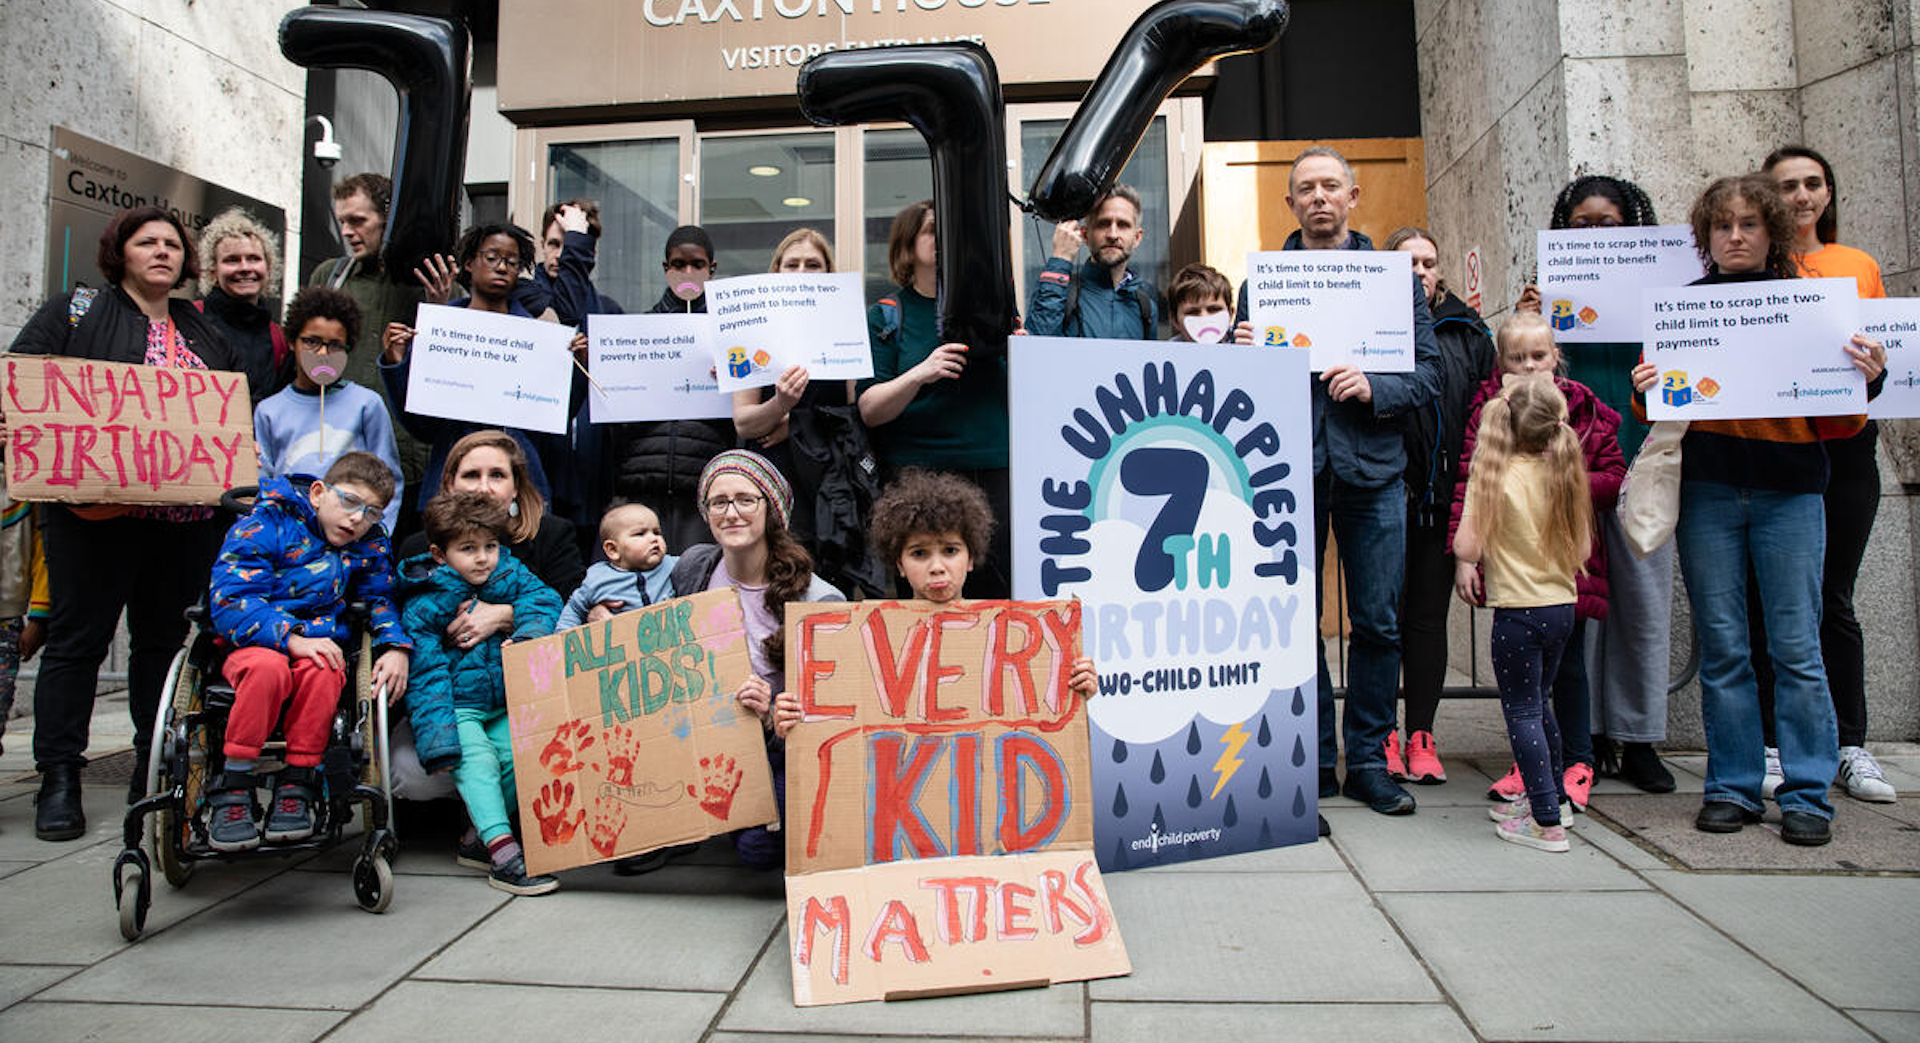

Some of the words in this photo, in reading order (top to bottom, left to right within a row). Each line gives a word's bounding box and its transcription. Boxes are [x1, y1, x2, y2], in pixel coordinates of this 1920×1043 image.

[70, 152, 115, 175] Welcome
[116, 169, 128, 181] to
[1549, 242, 1563, 251] It's
[1567, 241, 1591, 250] time
[1594, 241, 1605, 249] to
[1608, 240, 1636, 250] scrap
[1639, 238, 1658, 248] the
[1661, 239, 1688, 247] two-
[1548, 256, 1573, 266] child
[1576, 256, 1600, 265] limit
[1603, 256, 1615, 264] to
[1617, 254, 1657, 264] benefit
[1257, 264, 1273, 274] It's
[1276, 264, 1300, 273] time
[1303, 264, 1314, 273] to
[1317, 265, 1343, 275] scrap
[1346, 264, 1362, 273] the
[1364, 265, 1388, 273] two-
[1548, 273, 1600, 283] payments
[732, 287, 756, 298] time
[758, 285, 768, 294] to
[771, 284, 797, 294] scrap
[799, 283, 815, 293] the
[1258, 280, 1284, 290] child
[1286, 280, 1310, 289] limit
[1313, 281, 1324, 289] to
[1327, 279, 1362, 290] benefit
[718, 304, 741, 316] child
[743, 299, 766, 312] limit
[769, 299, 780, 308] to
[782, 298, 817, 308] benefit
[1259, 297, 1311, 307] payments
[1654, 301, 1673, 313] It's
[1677, 299, 1706, 312] time
[1710, 300, 1724, 309] to
[1727, 297, 1763, 310] scrap
[1766, 294, 1789, 306] the
[1793, 293, 1826, 304] two-
[719, 315, 768, 331] payments
[1655, 318, 1686, 331] child
[1689, 317, 1719, 329] limit
[1723, 317, 1736, 327] to
[1740, 313, 1790, 326] benefit
[1865, 323, 1887, 332] end
[1889, 322, 1917, 332] child
[431, 327, 447, 338] It's
[449, 329, 473, 342] time
[475, 334, 486, 344] to
[488, 337, 508, 347] end
[510, 337, 534, 351] child
[615, 337, 638, 346] time
[639, 338, 651, 346] to
[652, 336, 670, 345] end
[672, 335, 696, 344] child
[1656, 337, 1720, 351] payments
[1885, 339, 1903, 349] UK
[428, 343, 469, 358] poverty
[471, 347, 481, 358] in
[484, 350, 501, 362] the
[502, 352, 518, 364] UK
[600, 351, 637, 362] poverty
[638, 351, 648, 360] in
[650, 350, 666, 360] the
[668, 351, 682, 360] UK
[7, 361, 240, 427] UNHAPPY
[1820, 387, 1853, 398] poverty
[12, 424, 242, 492] BIRTHDAY
[1061, 361, 1298, 586] UNHAPPIEST
[1040, 477, 1092, 597] THE
[564, 620, 627, 678] ALL
[638, 600, 696, 654] OUR
[796, 600, 1082, 723] EVERY
[1098, 667, 1202, 697] WO-CHILD
[1208, 662, 1261, 688] LIMIT
[865, 731, 1072, 866] KID
[1183, 827, 1222, 846] poverty
[795, 861, 1113, 986] MATTERS
